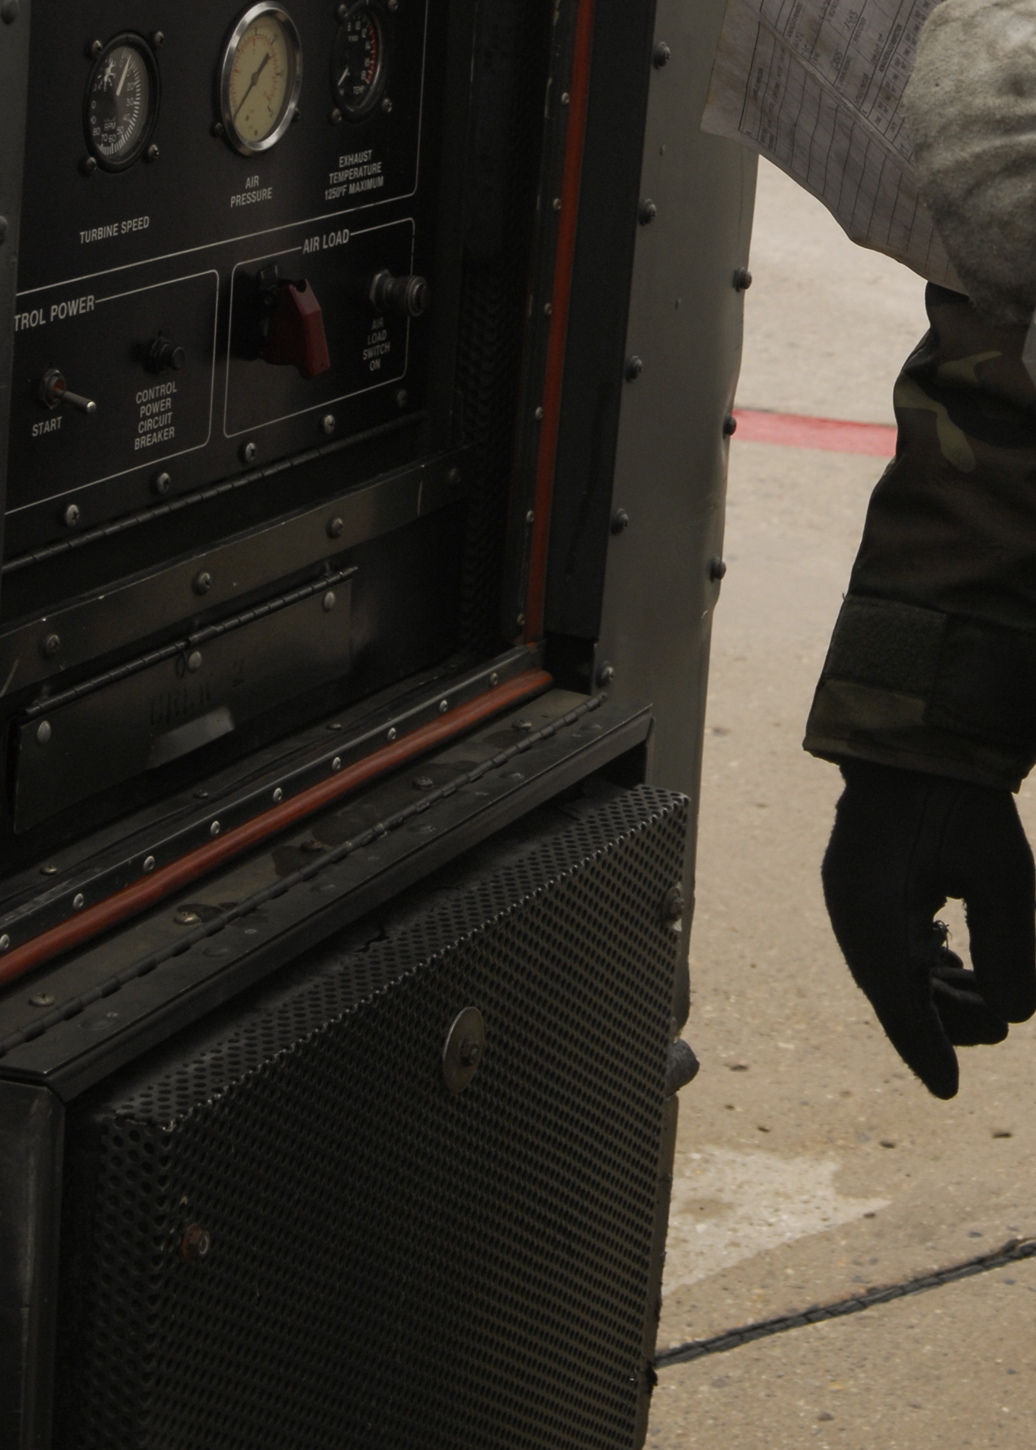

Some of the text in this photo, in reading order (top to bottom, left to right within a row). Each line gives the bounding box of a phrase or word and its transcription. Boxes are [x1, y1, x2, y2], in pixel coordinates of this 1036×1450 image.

[126, 82, 134, 91] 20
[126, 98, 134, 107] 30
[123, 113, 131, 121] 40
[92, 127, 101, 137] 80
[104, 122, 117, 132] RPM
[116, 126, 124, 135] 50
[101, 133, 108, 142] 70
[108, 134, 117, 144] 60
[339, 150, 372, 168] EXHAUST
[245, 175, 259, 189] AIR
[329, 162, 382, 185] TEMPERATURE
[348, 176, 384, 195] MAXIMUM
[230, 187, 273, 208] PRESSURE
[80, 216, 150, 244] TURBINE SPEED
[302, 228, 350, 254] AIR LOAD
[50, 295, 95, 322] POWER
[372, 317, 384, 330] AIR
[368, 330, 387, 345] LOAD
[363, 341, 390, 360] SWITCH
[370, 358, 381, 371] ON
[136, 381, 177, 404] CONTROL
[140, 398, 172, 418] POWER
[32, 416, 62, 437] START
[138, 412, 173, 434] CIRCUIT
[134, 426, 175, 450] BREAKER
